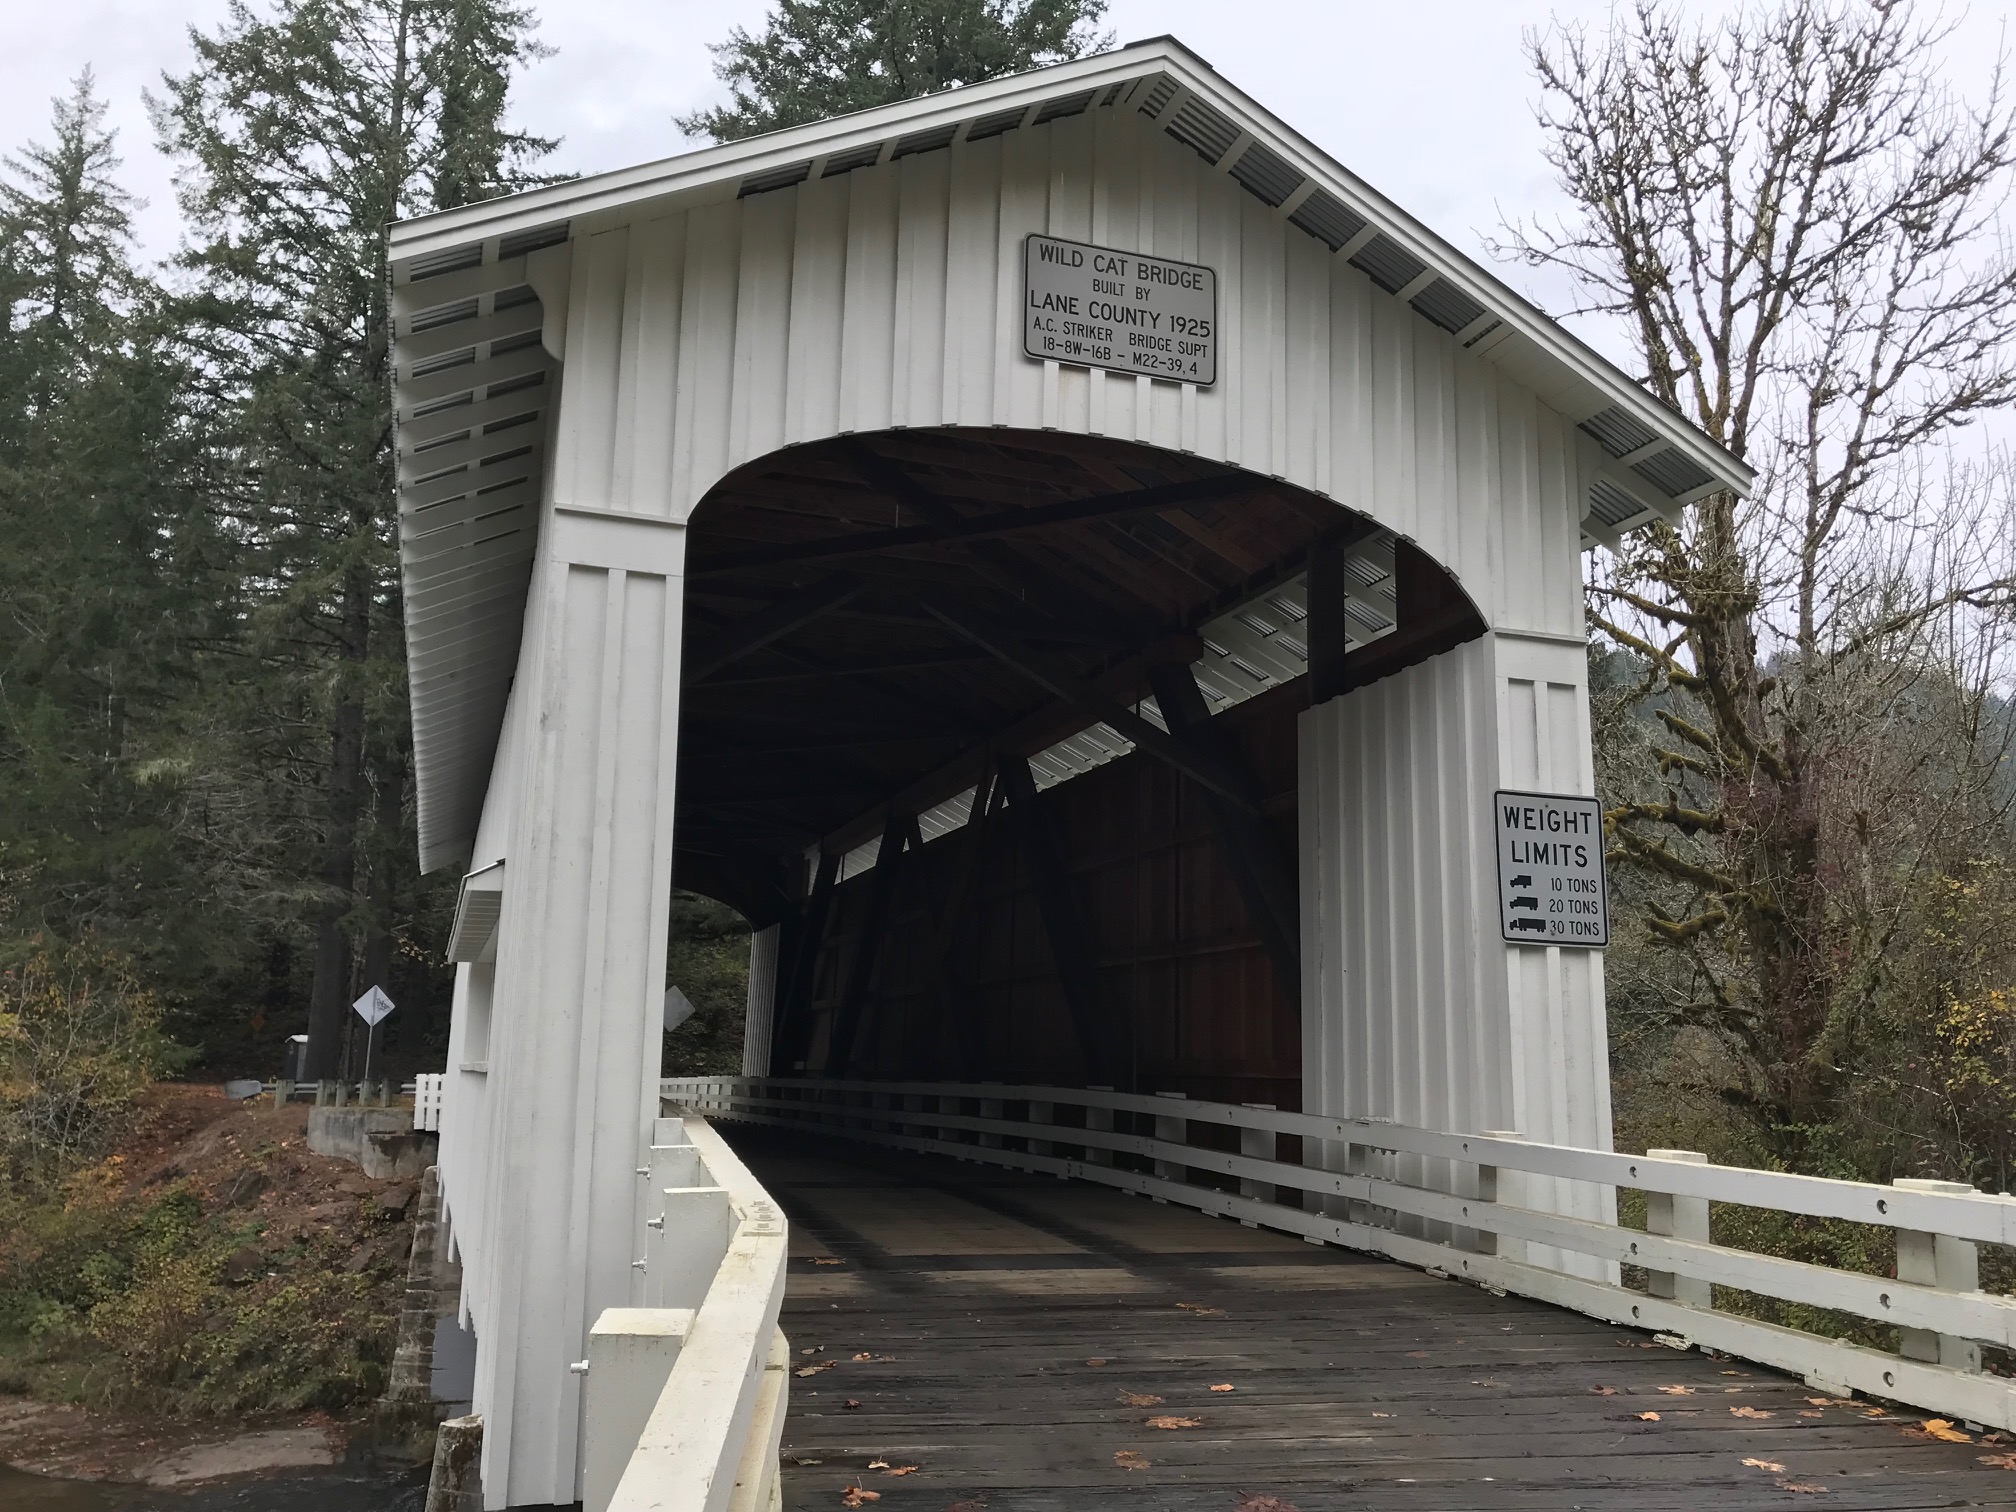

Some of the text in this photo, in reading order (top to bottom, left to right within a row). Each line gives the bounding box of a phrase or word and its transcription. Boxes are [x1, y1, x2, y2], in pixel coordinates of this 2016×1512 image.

[1040, 244, 1203, 291] WILD CAT BRIDGE
[1093, 278, 1150, 301] BUILT BY
[1030, 290, 1210, 338] LANE COUNTY 1925
[1033, 316, 1207, 358] A.C. STRIKER BRIDGE SUPT
[1043, 336, 1111, 360] 18-8W-16B
[1504, 806, 1591, 834] WEIGHT
[1511, 840, 1588, 867] LIMITS
[1551, 878, 1597, 893] 10 TONS
[1550, 899, 1598, 914] 20 TONS
[1550, 921, 1599, 936] 30 TONS
